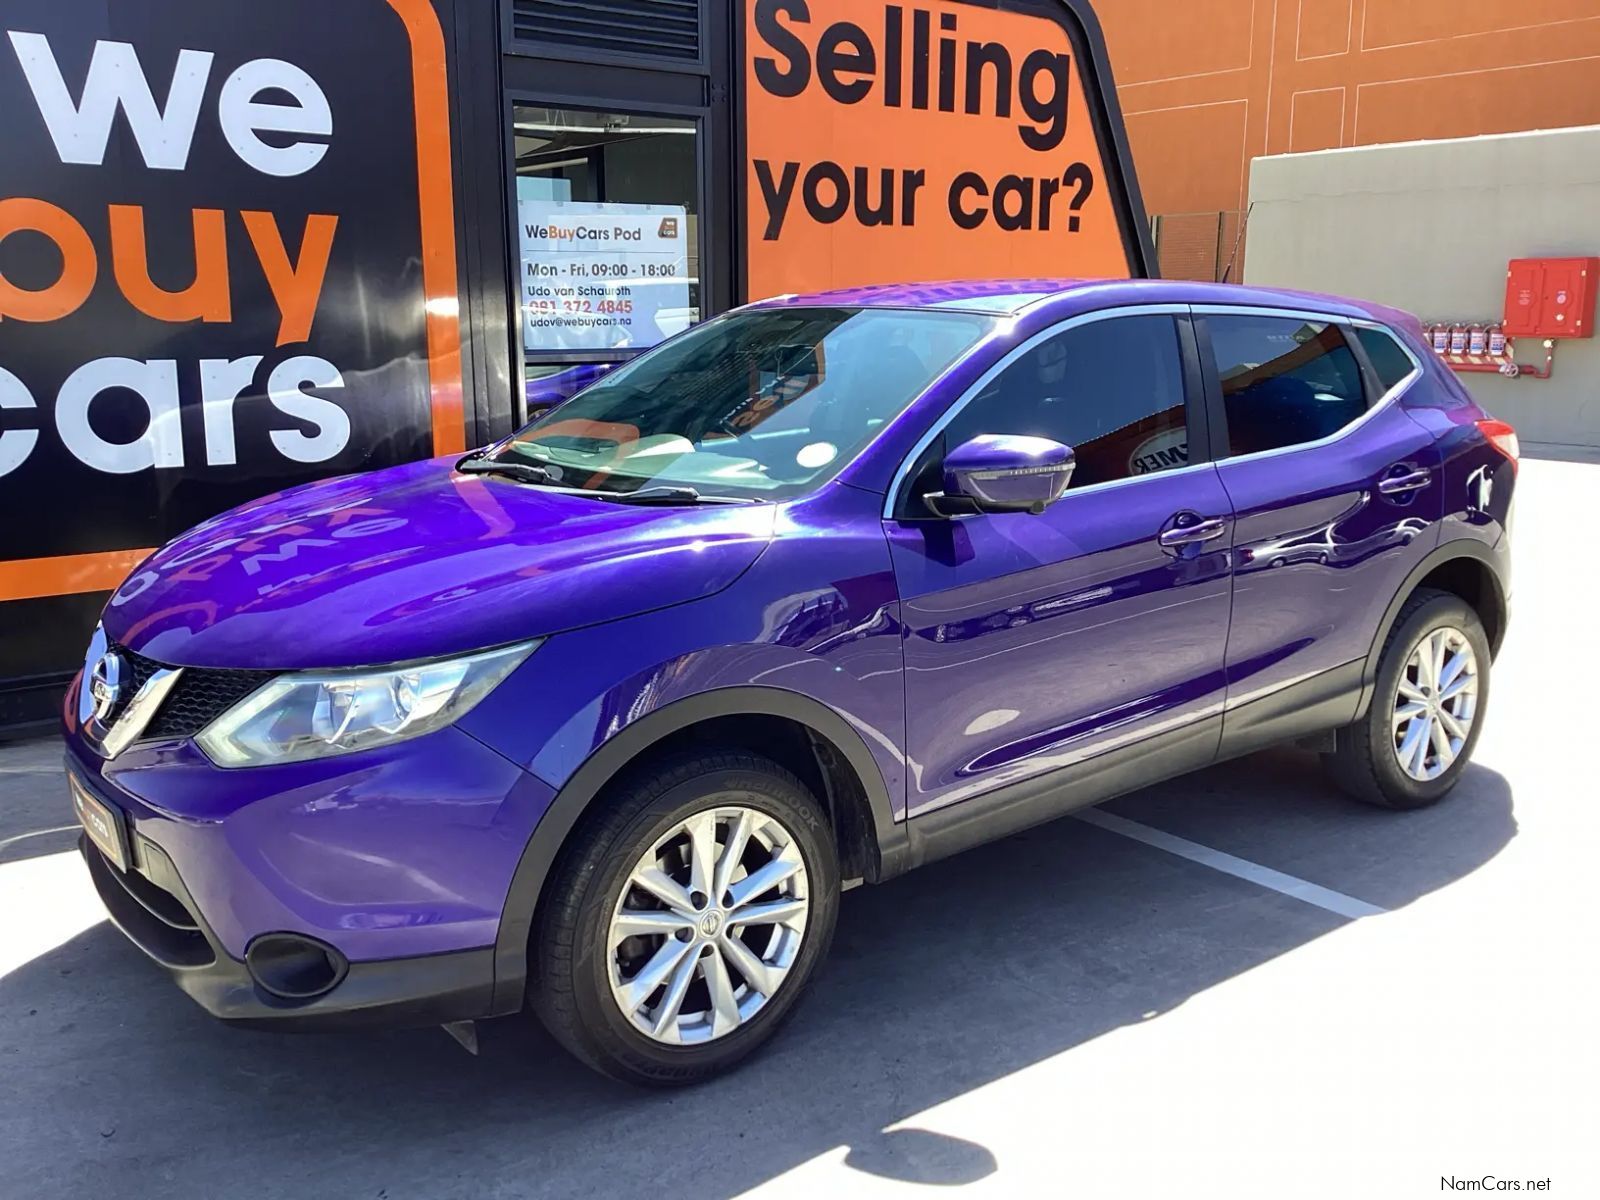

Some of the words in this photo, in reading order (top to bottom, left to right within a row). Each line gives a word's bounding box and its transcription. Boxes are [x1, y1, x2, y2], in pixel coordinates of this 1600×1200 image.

[753, 0, 1070, 152] Selling
[7, 30, 333, 177] we
[753, 159, 925, 241] your
[948, 162, 1094, 233] car?
[525, 224, 610, 242] WeBuyCars
[614, 227, 642, 241] Pod
[527, 263, 558, 277] Mon
[570, 264, 589, 278] Fri,
[591, 264, 628, 277] 09:00
[640, 264, 676, 277] 18:00
[528, 286, 550, 296] Udo
[554, 288, 574, 296] van
[577, 286, 631, 296] Schauroth
[563, 301, 592, 315] 372
[596, 300, 633, 314] 4845
[530, 317, 632, 328] udov@webuycars.na
